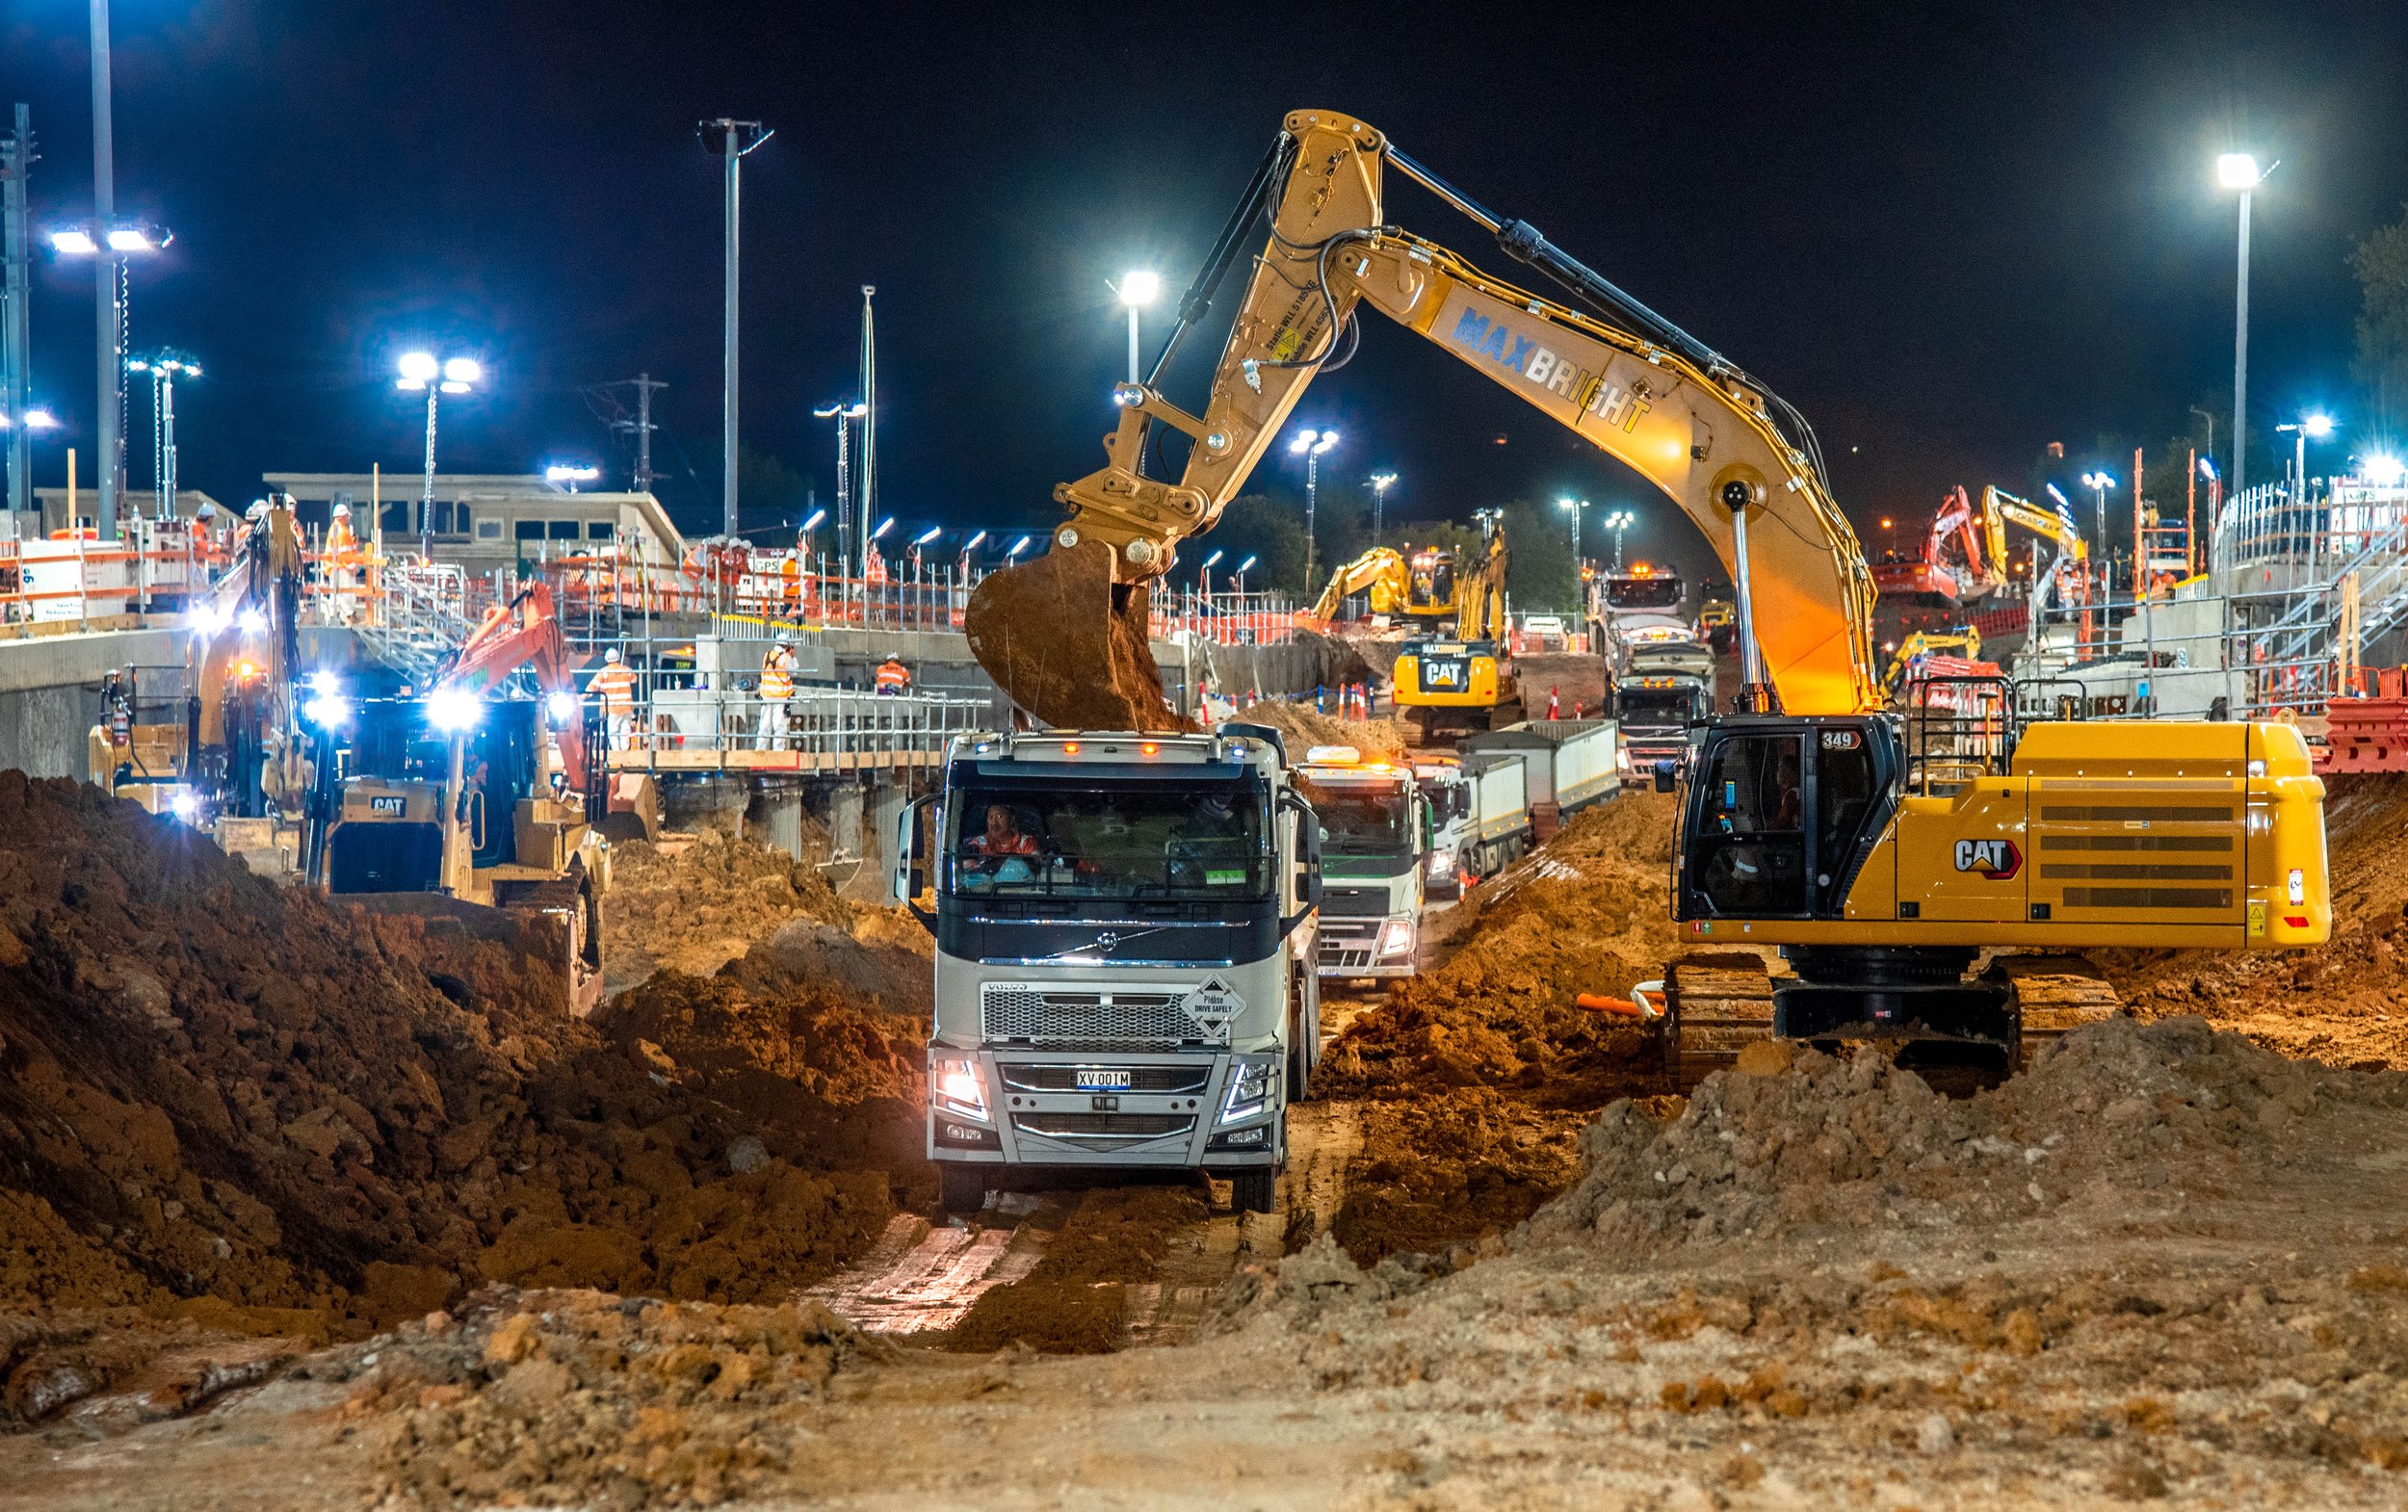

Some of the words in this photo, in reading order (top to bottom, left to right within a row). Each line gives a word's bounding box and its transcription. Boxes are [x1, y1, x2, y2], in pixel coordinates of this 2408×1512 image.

[1265, 325, 1286, 351] Static
[1279, 308, 1296, 327] WLL
[1302, 324, 1320, 343] WLL
[1453, 306, 1651, 433] MAXBRIGHT
[755, 560, 778, 571] GPS
[1426, 663, 1461, 686] CAT
[1823, 732, 1851, 747] 349
[374, 797, 404, 817] CAT
[1955, 840, 2006, 871] CAT
[1204, 995, 1224, 1004] Please
[1212, 1004, 1233, 1013] SAFELY
